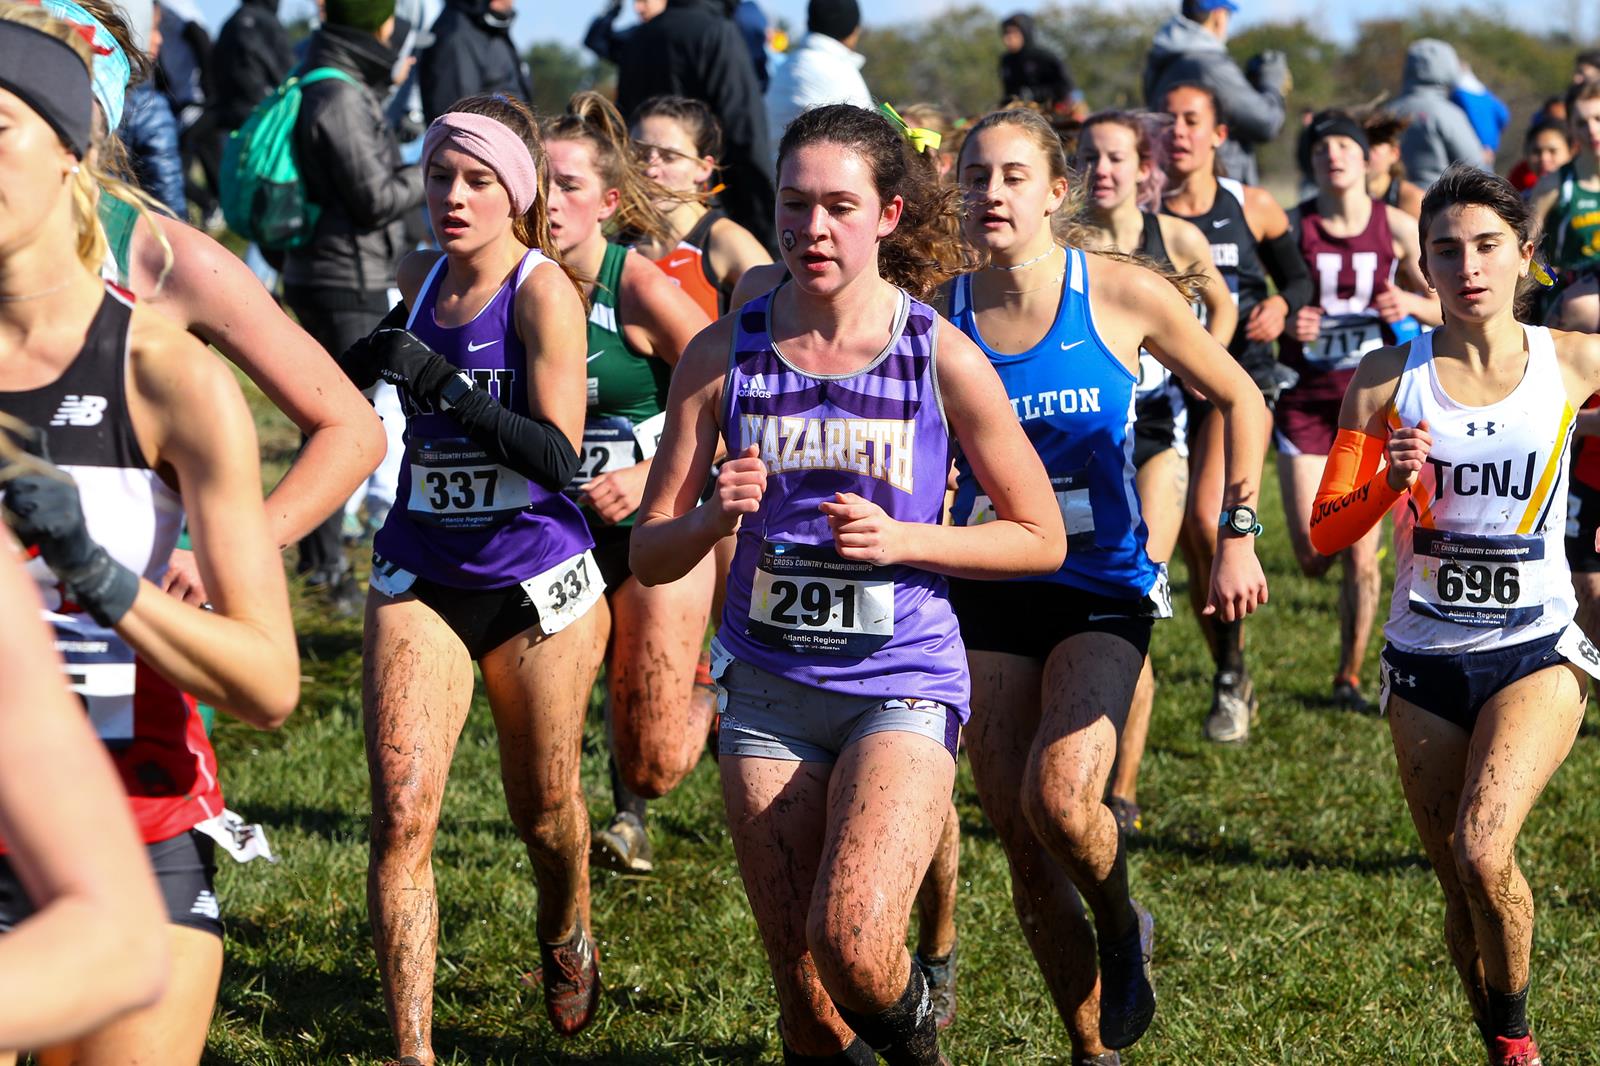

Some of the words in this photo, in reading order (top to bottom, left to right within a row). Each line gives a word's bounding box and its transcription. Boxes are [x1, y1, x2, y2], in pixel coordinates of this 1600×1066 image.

[1316, 252, 1377, 316] U
[1320, 329, 1366, 355] 717
[738, 389, 772, 399] adidas
[740, 413, 916, 495] NAZARETH
[426, 469, 498, 510] 337
[1426, 450, 1537, 501] TCNJ
[794, 559, 823, 568] COUNTRY
[823, 562, 873, 572] CHAMPIONSHIPS
[1440, 545, 1459, 553] CROSS
[1459, 546, 1485, 555] COUNTRY
[1485, 547, 1530, 556] CHAMPIONSHIPS
[548, 555, 591, 610] 337
[1437, 564, 1520, 604] 696
[770, 580, 855, 629] 291
[1476, 611, 1507, 620] Regional
[782, 633, 812, 642] Atlantic
[813, 635, 848, 645] Regional
